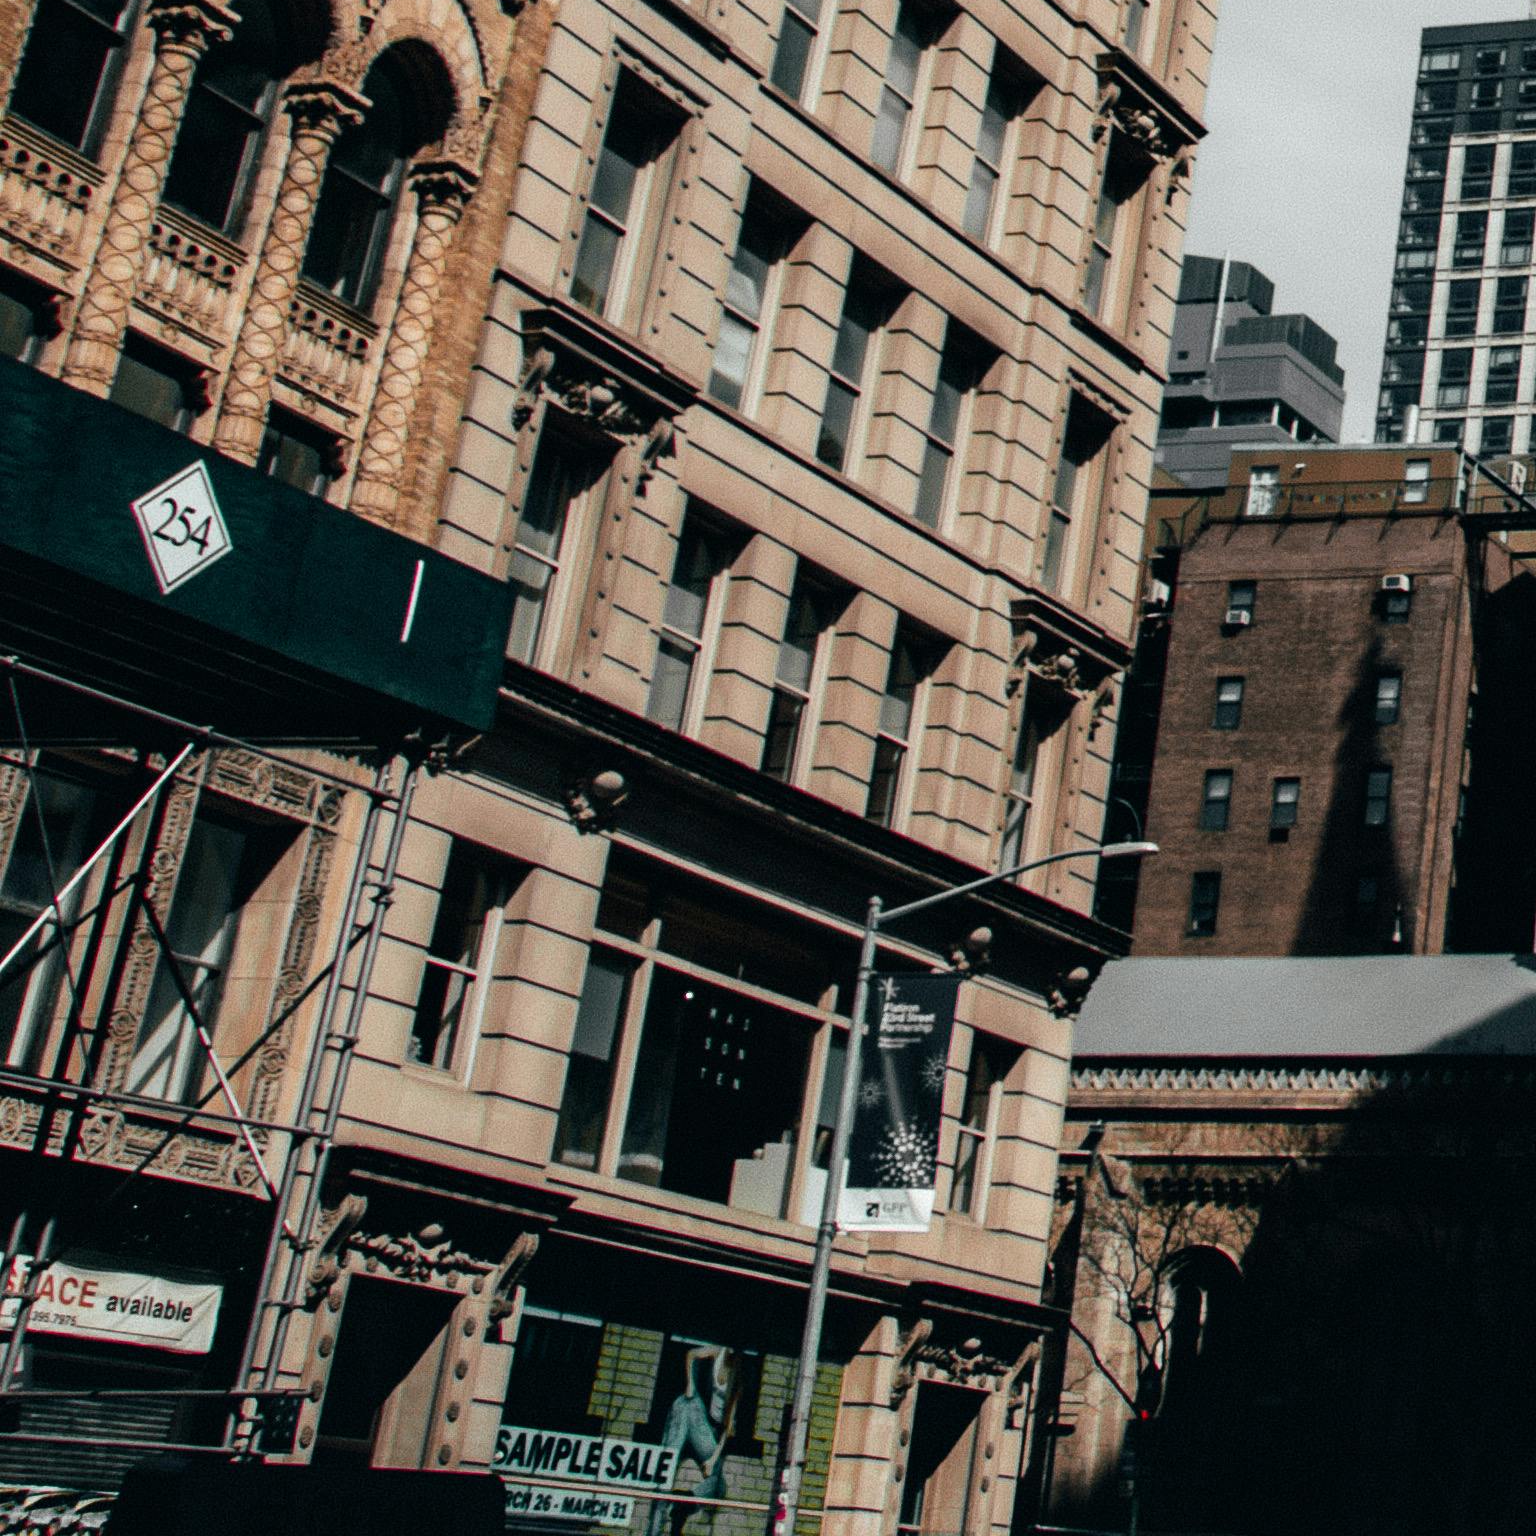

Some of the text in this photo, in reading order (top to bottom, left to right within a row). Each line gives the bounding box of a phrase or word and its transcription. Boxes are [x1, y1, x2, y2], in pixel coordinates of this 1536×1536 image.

[153, 497, 212, 555] 254
[106, 1295, 193, 1322] available
[493, 1429, 674, 1483] SAMPLE SALE
[533, 1493, 552, 1512] 26
[561, 1496, 611, 1517] MARCH
[612, 1502, 627, 1519] 31
